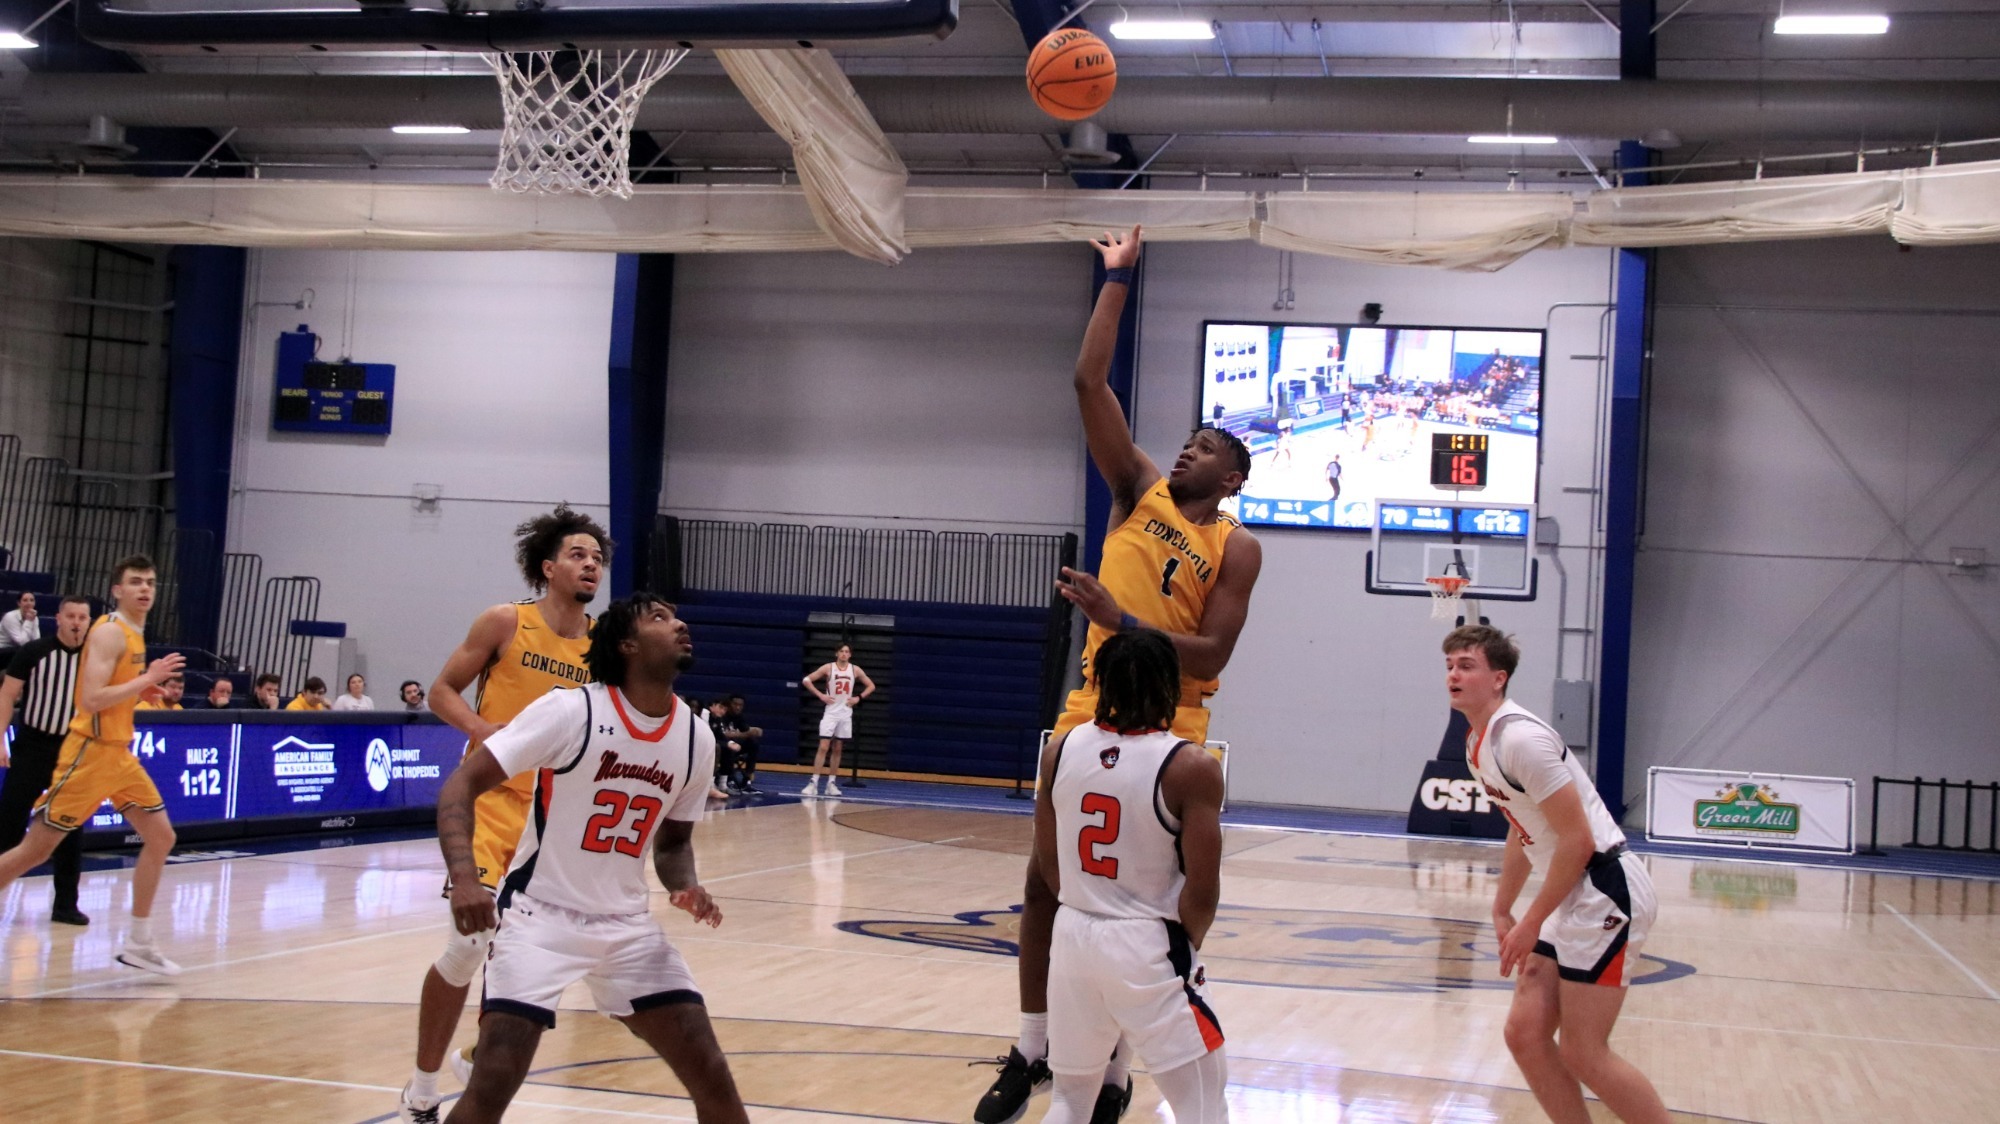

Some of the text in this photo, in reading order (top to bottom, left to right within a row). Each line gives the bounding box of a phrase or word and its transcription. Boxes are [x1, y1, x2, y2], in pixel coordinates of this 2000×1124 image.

[281, 388, 308, 397] BEARS
[357, 391, 384, 400] GUEST
[1451, 434, 1486, 450] 1:11
[1451, 454, 1478, 484] 16
[1243, 502, 1269, 519] 74
[1473, 513, 1521, 533] 1:12
[1160, 556, 1181, 597] 1
[835, 680, 850, 695] 24
[274, 750, 334, 763] AMERICAN FAMILY
[391, 748, 421, 762] SUMMIT
[279, 764, 330, 773] INSURANCE
[391, 764, 440, 779] ORTHOPEDICS
[593, 750, 675, 795] Marauders
[180, 768, 222, 797] 1:12
[581, 788, 663, 858] 23
[1698, 805, 1794, 828] Green Mill
[1078, 791, 1121, 880] 2
